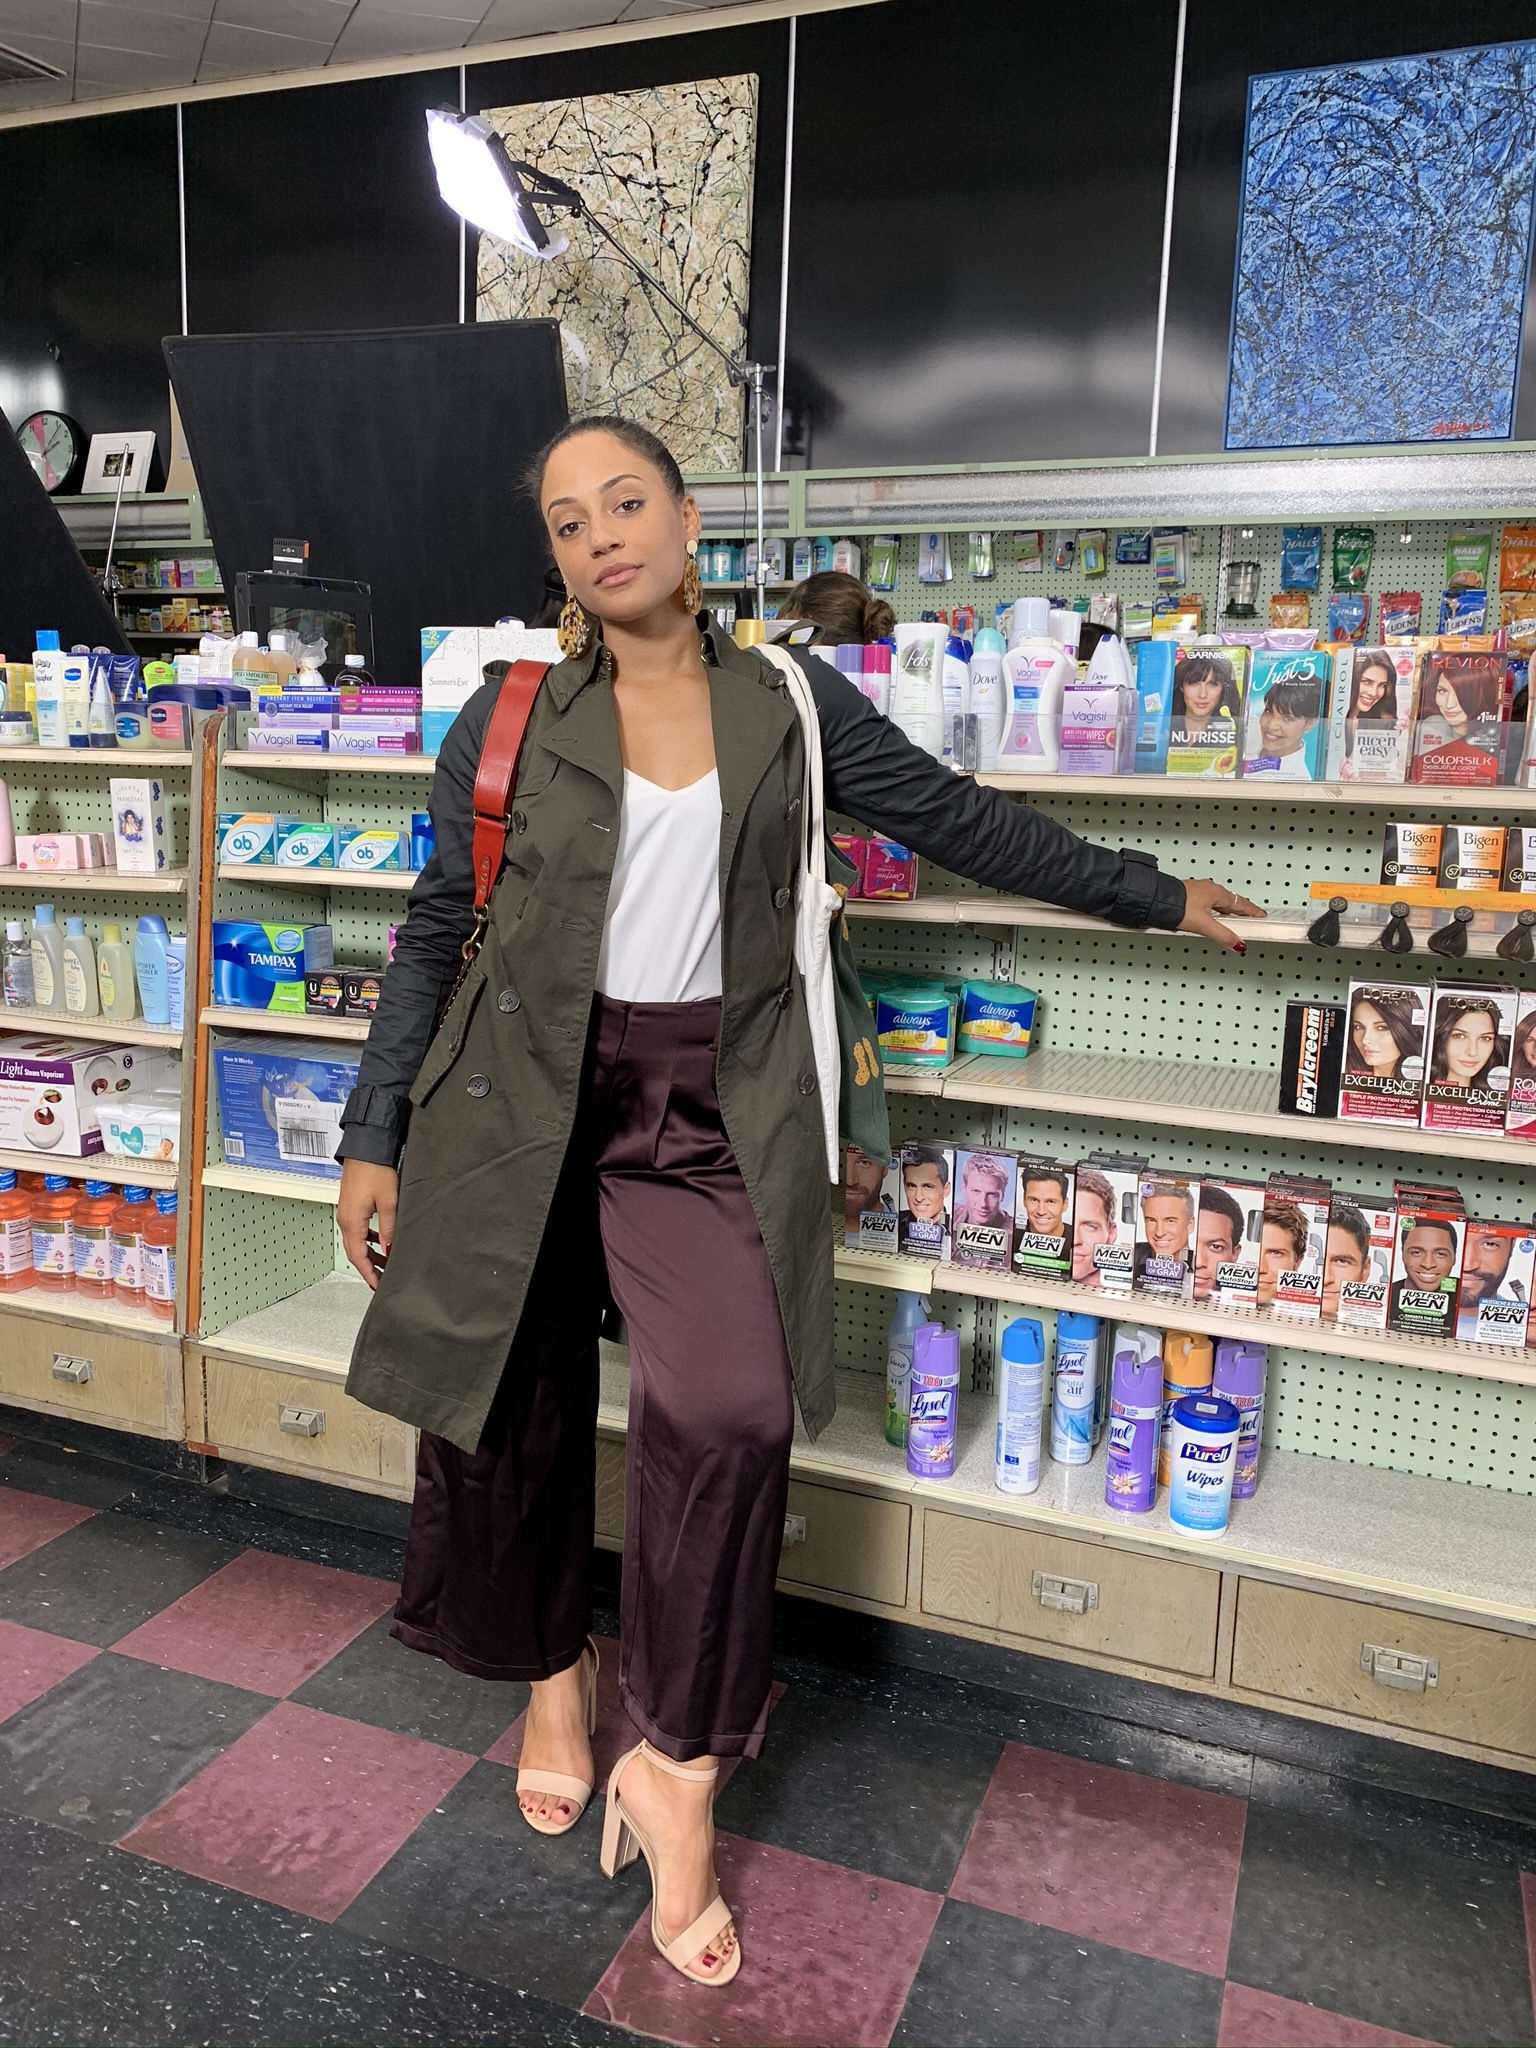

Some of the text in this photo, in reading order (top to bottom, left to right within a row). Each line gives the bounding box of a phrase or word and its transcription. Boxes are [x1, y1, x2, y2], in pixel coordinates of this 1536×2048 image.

[1286, 540, 1318, 549] HALLS
[1387, 617, 1417, 633] LUDEN'S
[1446, 614, 1482, 632] LUDEN'S
[1187, 651, 1233, 660] GARNIER
[1430, 656, 1503, 669] REVLON
[972, 672, 997, 685] Dove
[1016, 669, 1041, 680] Vagisil
[1092, 672, 1108, 680] Dove
[1252, 656, 1318, 692] Just 5
[429, 676, 469, 686] Summer's Eve
[1334, 659, 1348, 739] CLAIROL
[1072, 710, 1106, 724] Vagisil
[262, 734, 294, 747] Vagisil
[1086, 730, 1106, 740] WIPES
[1171, 730, 1237, 744] NUTRISSE
[343, 736, 376, 751] Vagisil
[1360, 747, 1392, 758] easy
[1423, 755, 1492, 766] COLORSILK
[1402, 830, 1437, 846] Bigen
[1464, 832, 1498, 849] Bigen
[1387, 864, 1398, 872] 58
[1448, 868, 1458, 876] 57
[876, 873, 904, 882] Carefree
[1512, 872, 1522, 880] 56
[1332, 899, 1346, 907] 59
[1394, 904, 1406, 912] 58
[1521, 912, 1534, 922] 56
[248, 952, 296, 968] TAMPAX
[309, 982, 316, 992] U
[350, 986, 357, 996] U
[980, 1002, 1019, 1021] always
[892, 1012, 934, 1030] always
[1296, 1008, 1320, 1114] Brylcreem
[0, 1060, 64, 1079] Light Steam Vaporizer
[1344, 1074, 1419, 1092] EXCELLENCE
[1367, 1095, 1400, 1103] PROTECTION
[1429, 1086, 1507, 1102] EXCELLENCE
[1452, 1105, 1485, 1113] PROTECTION
[861, 1222, 896, 1232] MEN
[912, 1223, 939, 1232] TOUCH
[988, 1228, 1006, 1236] FOR
[918, 1231, 938, 1240] GRAY
[960, 1230, 1004, 1246] MEN
[1024, 1242, 1061, 1252] MEN
[1095, 1249, 1131, 1260] MEN
[1097, 1258, 1130, 1266] AutoStop
[1149, 1260, 1180, 1270] TOUCH
[1157, 1268, 1180, 1278] GRAY
[1219, 1268, 1257, 1279] MEN
[1280, 1272, 1300, 1280] JUST
[1220, 1276, 1254, 1284] AutoStop
[1280, 1278, 1319, 1289] MEN
[1343, 1282, 1386, 1292] JUST FOR
[1342, 1288, 1384, 1301] MEN
[1404, 1291, 1427, 1299] JUST
[1401, 1296, 1445, 1309] MEN
[1480, 1312, 1524, 1324] MEN
[1058, 1354, 1086, 1370] Lysol
[1059, 1378, 1084, 1386] neutra
[1067, 1385, 1083, 1395] air
[912, 1393, 948, 1417] Lysol
[919, 1426, 948, 1434] Disinfectant
[1239, 1416, 1258, 1433] sol
[1108, 1422, 1132, 1440] ysol
[1186, 1444, 1228, 1462] Purell
[1116, 1463, 1132, 1472] Spray
[1187, 1470, 1225, 1488] Wipes
